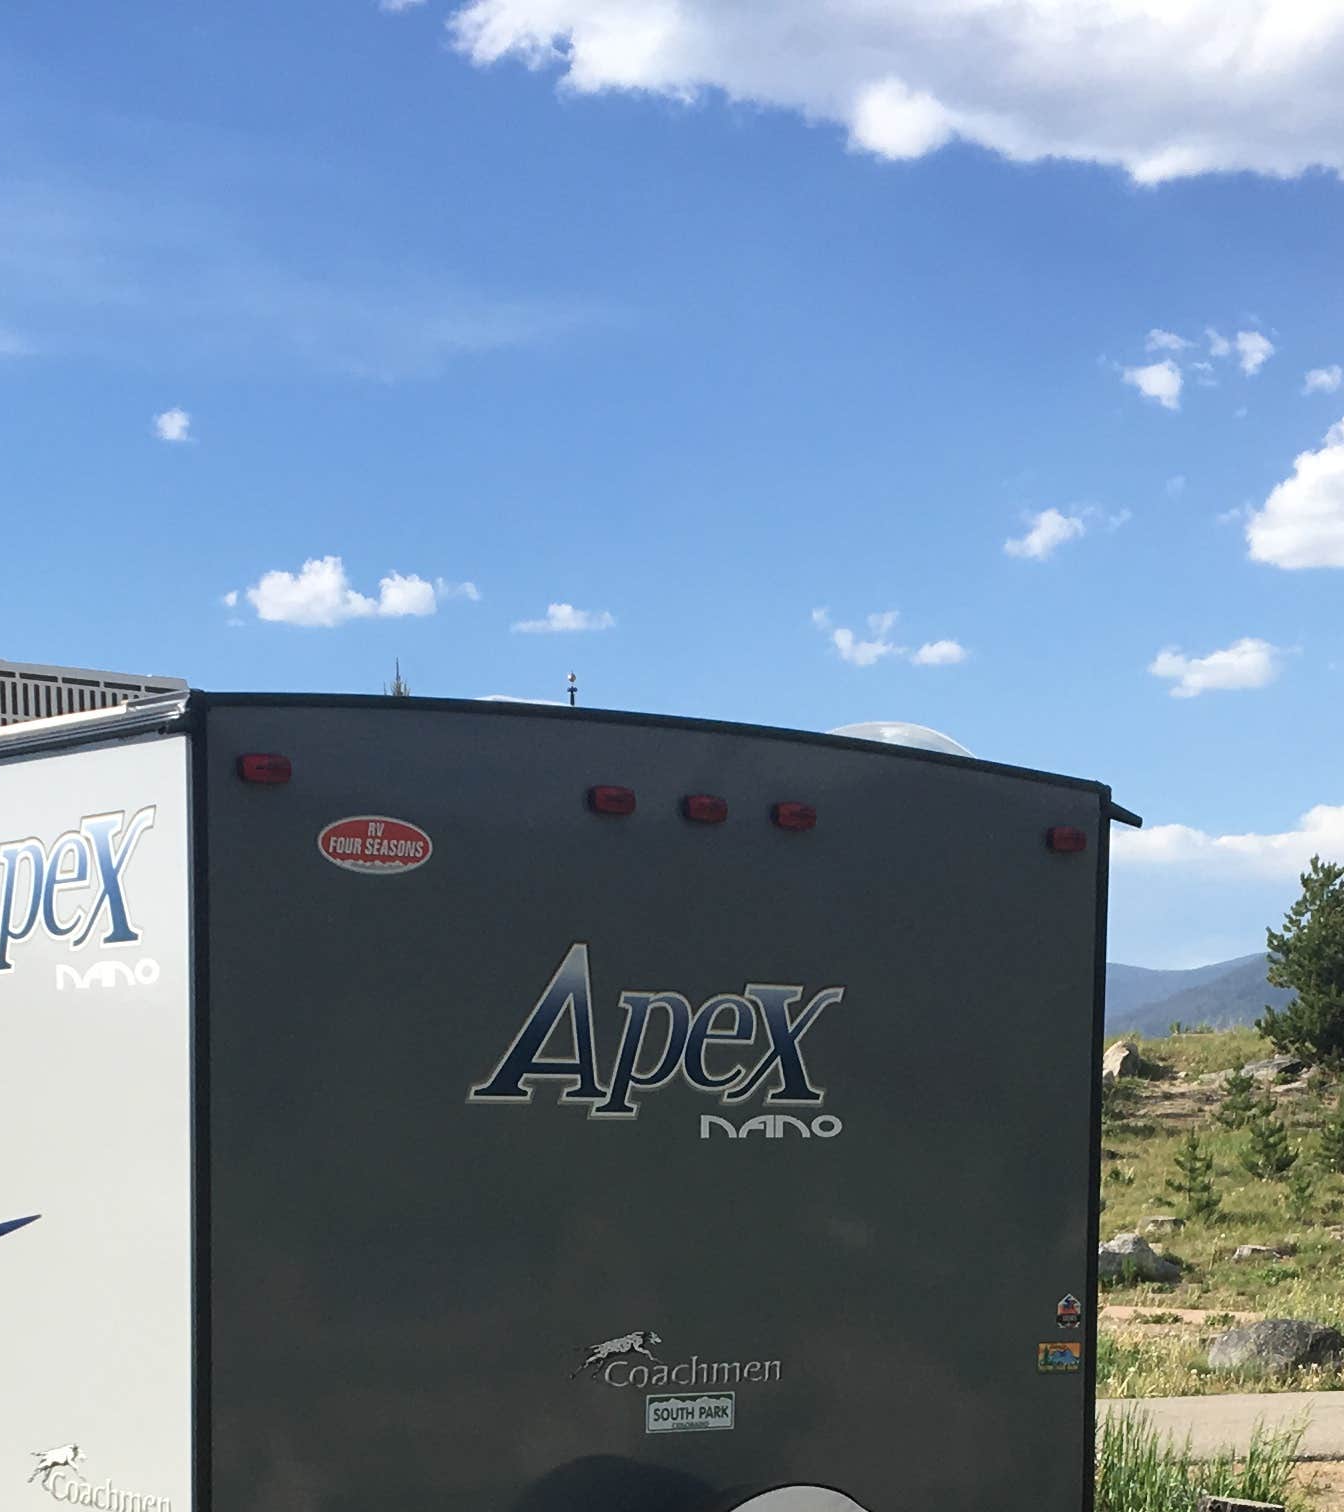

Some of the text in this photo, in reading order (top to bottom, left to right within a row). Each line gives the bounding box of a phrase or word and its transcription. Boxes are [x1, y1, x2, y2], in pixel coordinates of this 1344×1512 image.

[367, 822, 385, 837] RV
[328, 837, 424, 858] FOUR SEASONS
[604, 1355, 782, 1388] Coachmen
[653, 1405, 729, 1422] SOUTH PARK
